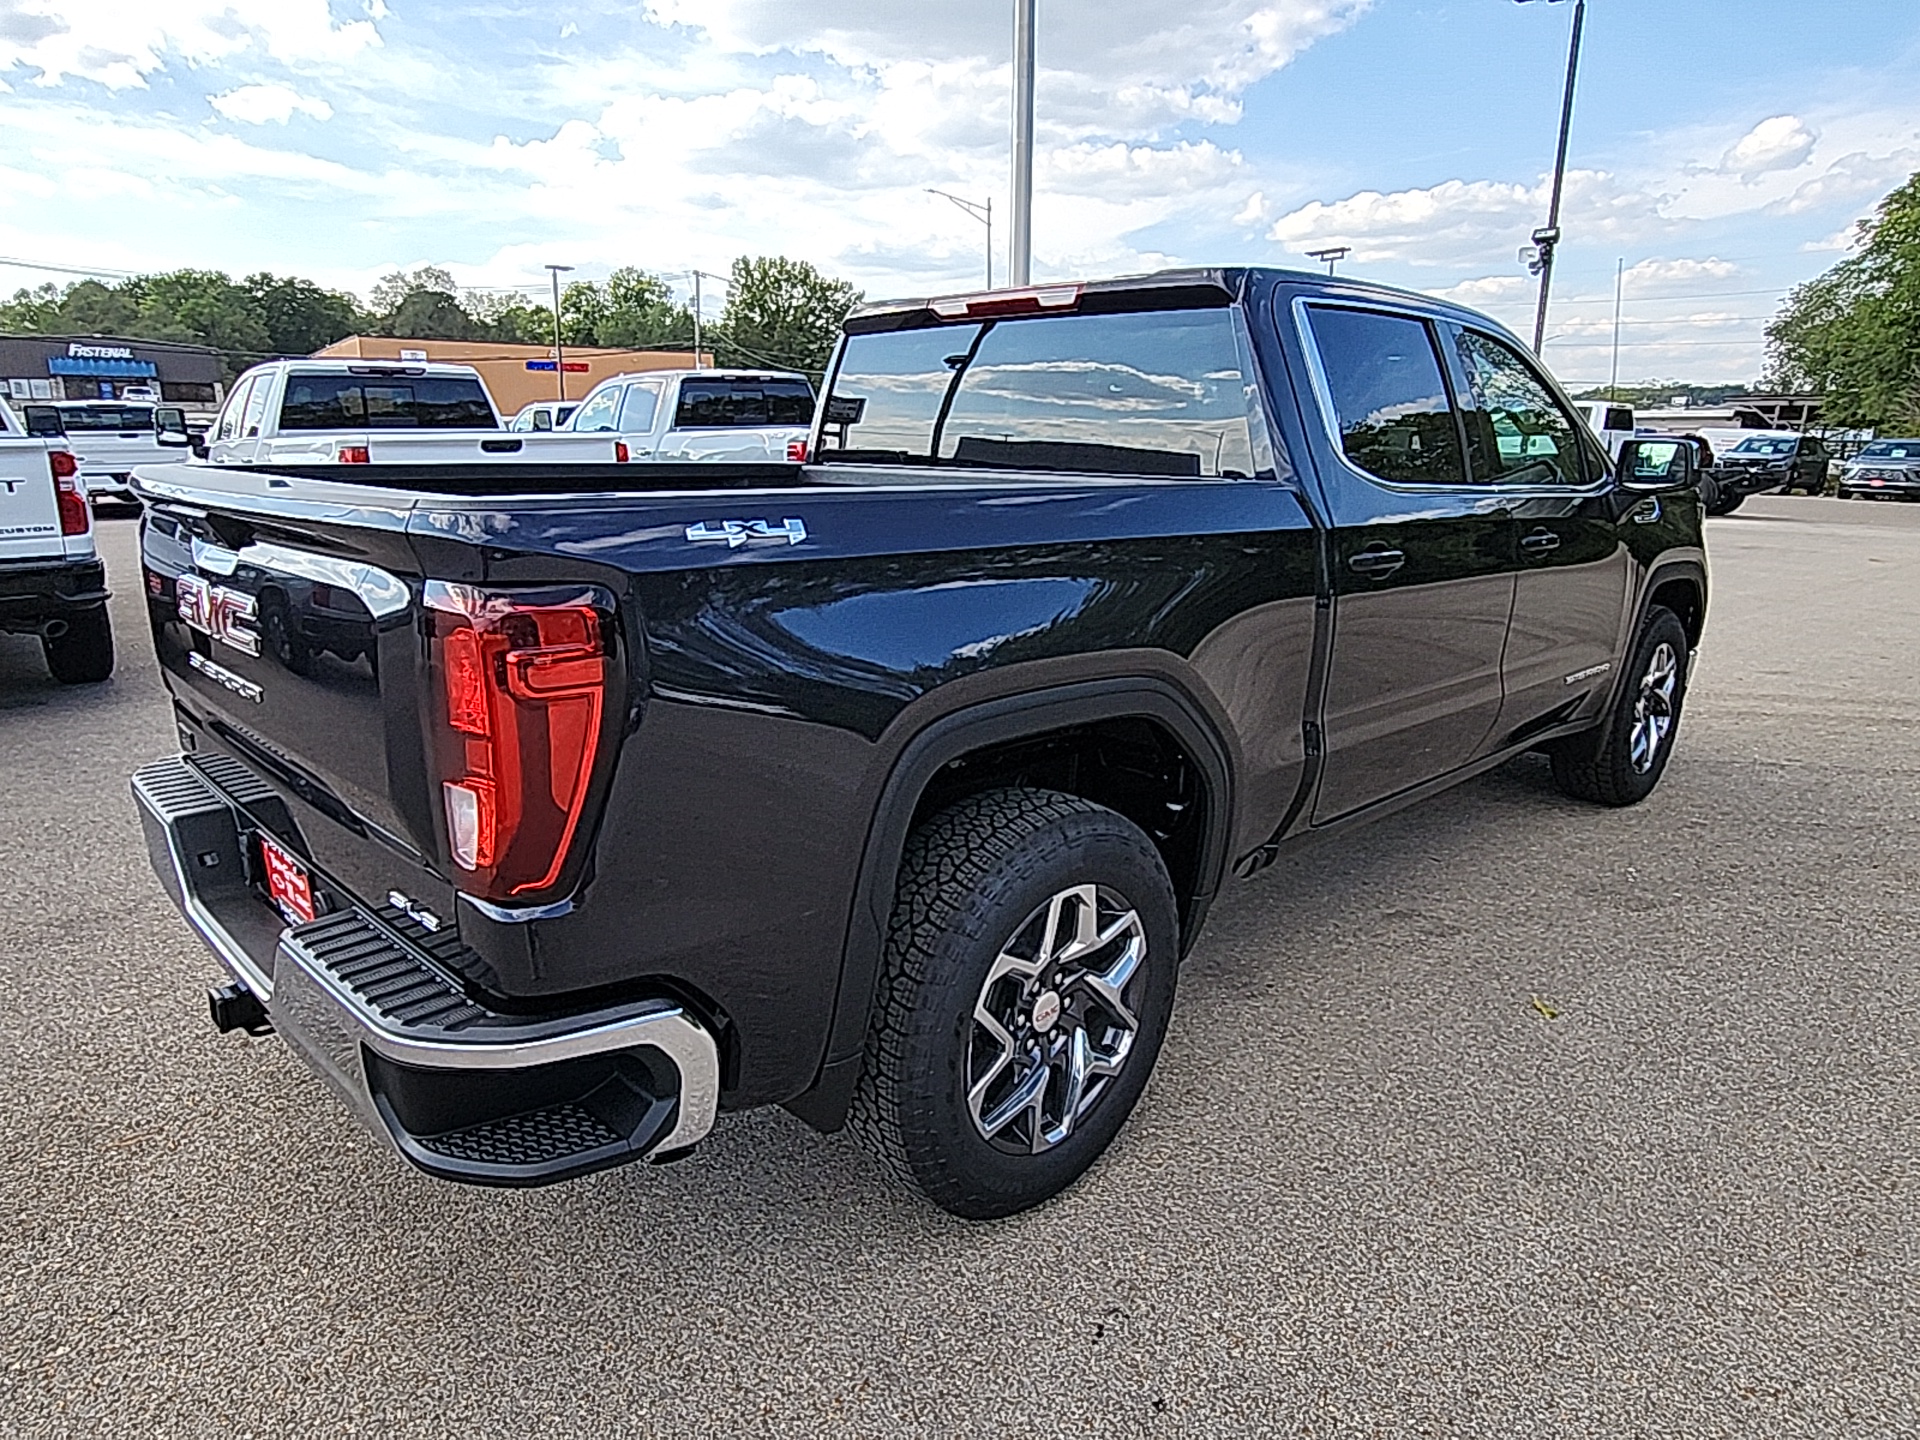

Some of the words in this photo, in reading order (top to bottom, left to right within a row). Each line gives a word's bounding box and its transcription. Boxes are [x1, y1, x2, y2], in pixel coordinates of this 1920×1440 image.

[68, 343, 134, 359] FASTENAL
[176, 566, 262, 658] GMC
[1035, 1004, 1059, 1023] GMC
